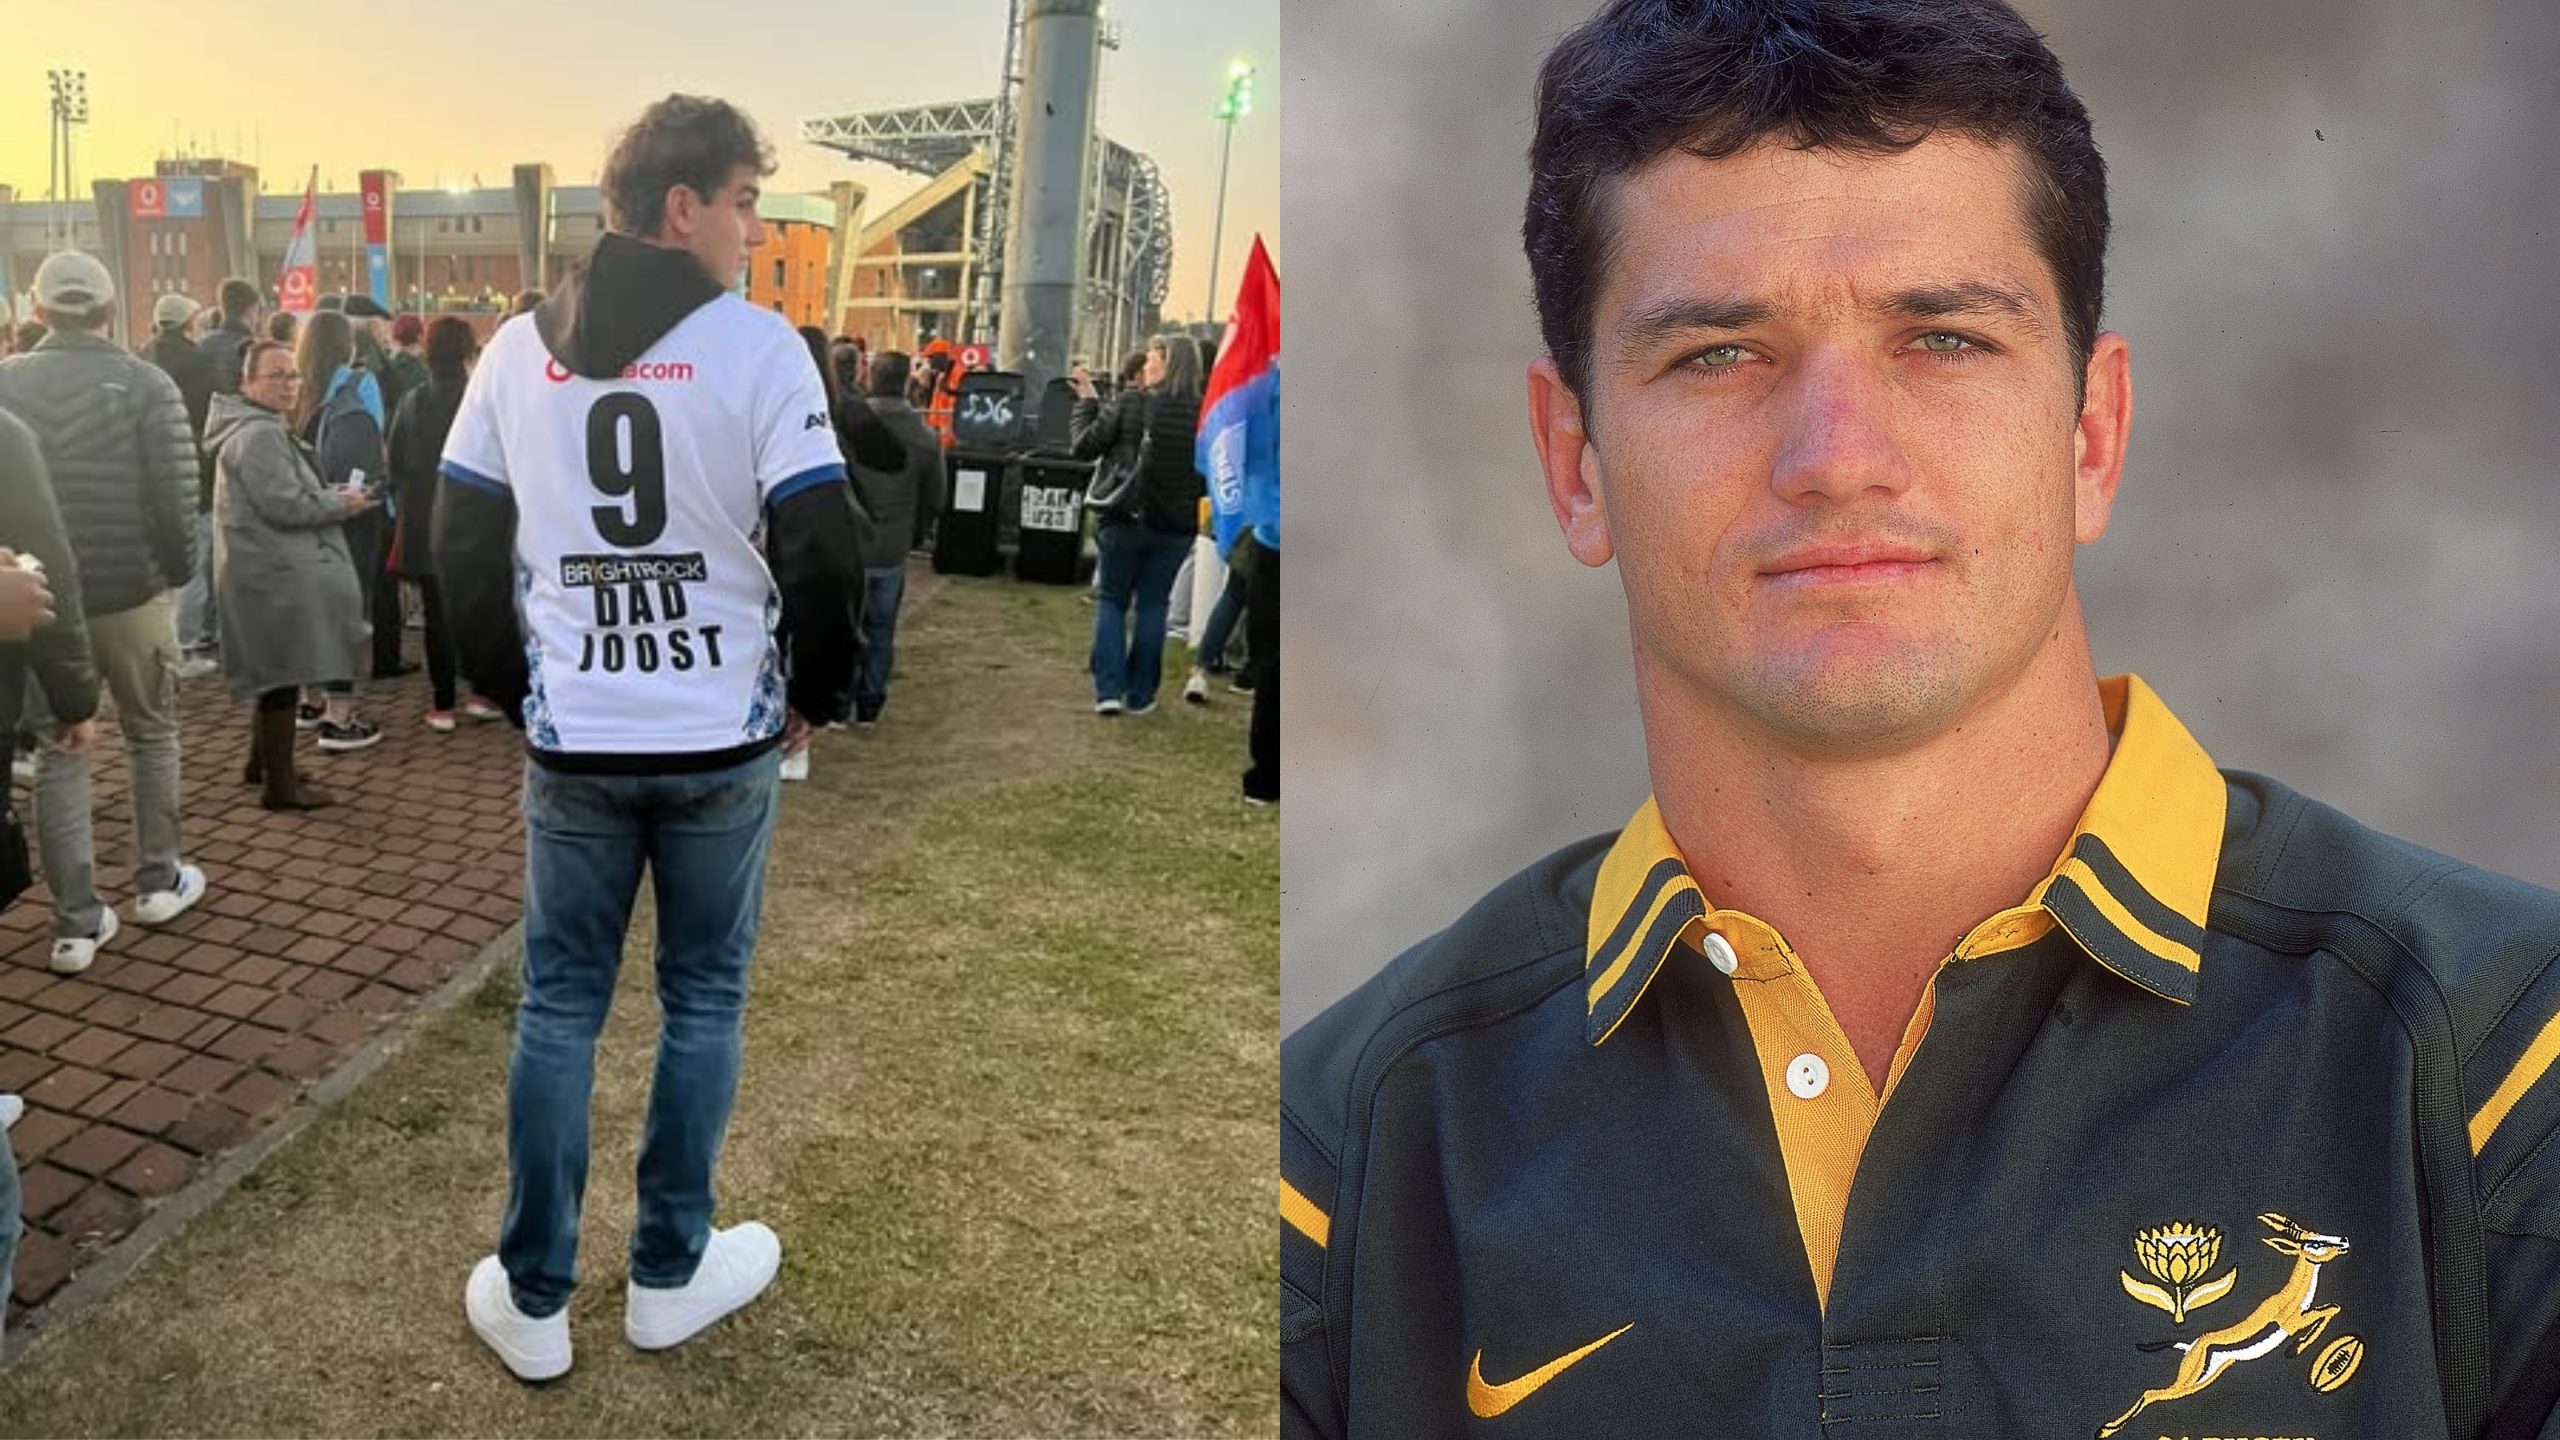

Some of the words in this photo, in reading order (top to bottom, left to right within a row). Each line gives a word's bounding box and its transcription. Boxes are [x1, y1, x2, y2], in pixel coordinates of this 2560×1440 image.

[618, 362, 693, 381] acom
[586, 391, 667, 548] 9
[564, 559, 703, 584] BRIGHTROCK
[594, 580, 687, 627] DAD
[579, 625, 722, 672] JOOST
